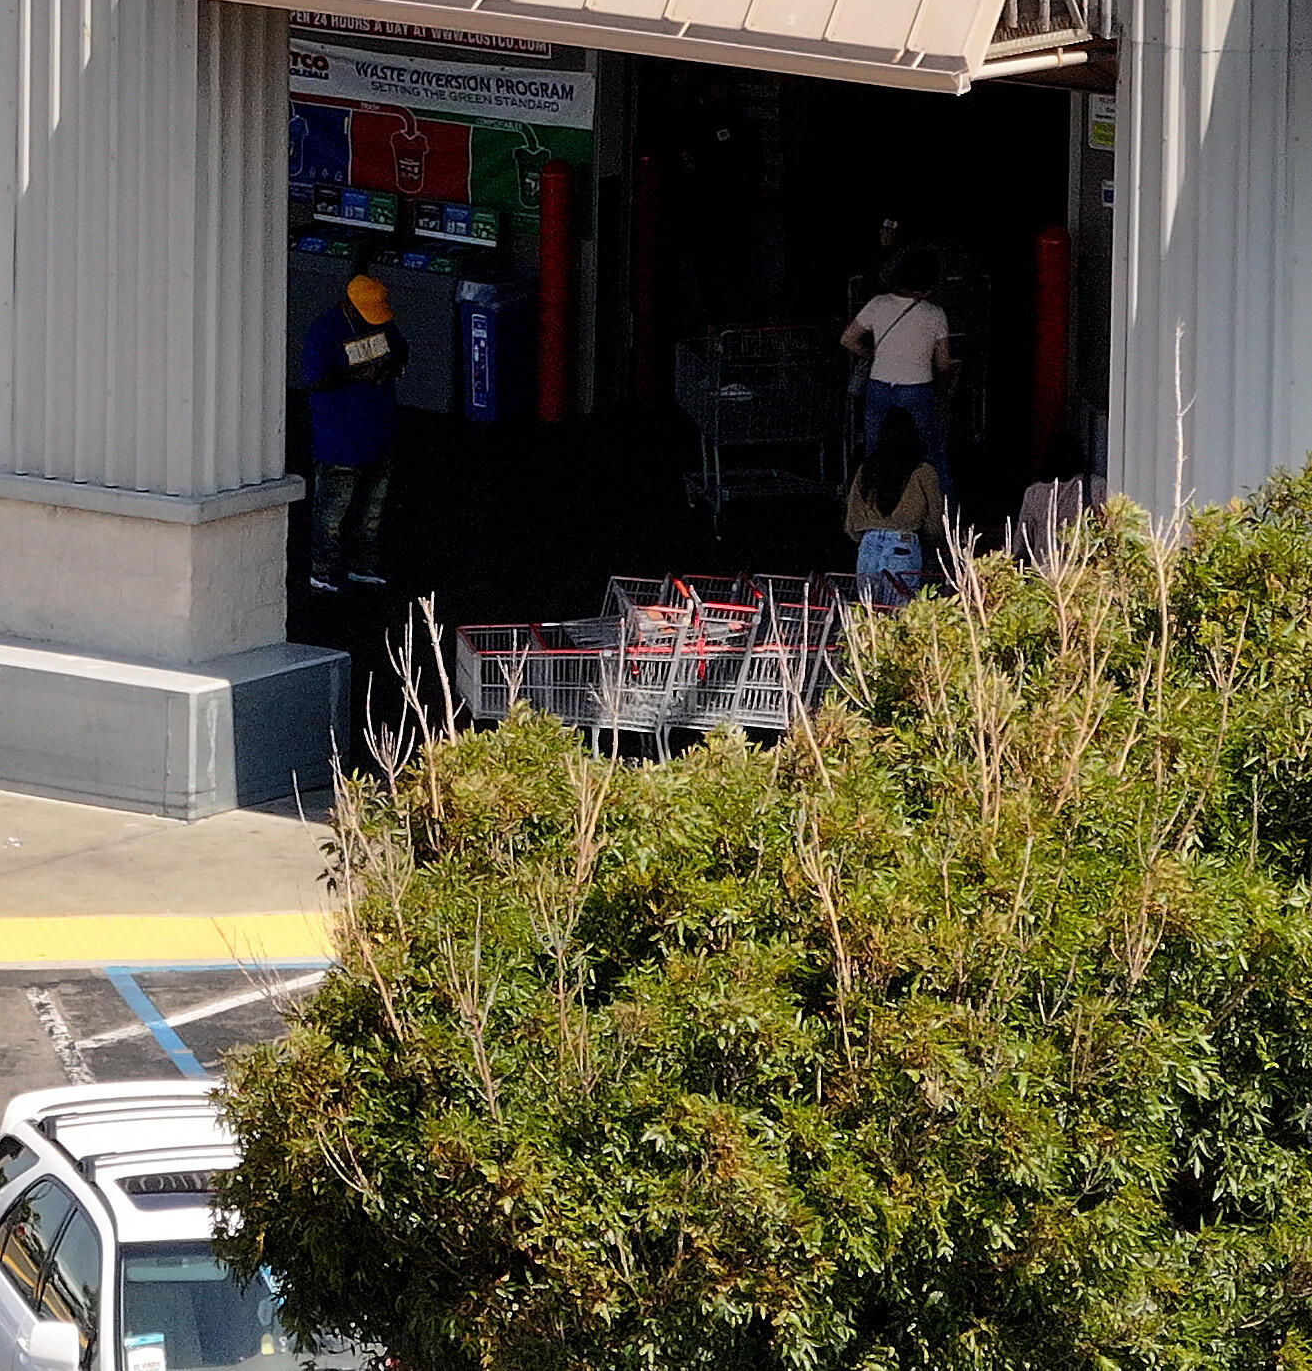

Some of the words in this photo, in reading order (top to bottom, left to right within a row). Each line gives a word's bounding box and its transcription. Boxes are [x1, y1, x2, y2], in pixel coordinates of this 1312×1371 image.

[289, 10, 311, 24] PEN
[313, 13, 328, 27] 24
[330, 15, 370, 31] HOURS
[373, 20, 384, 33] A
[385, 21, 409, 36] DAY
[413, 25, 427, 38] AT
[289, 51, 330, 71] TCO
[289, 67, 330, 81] OLESALE
[355, 60, 408, 83] WASTE
[409, 69, 491, 94] DIVERSION
[495, 76, 575, 101] PROGRAM
[371, 83, 421, 99] SETTING
[424, 88, 447, 103] THE
[449, 91, 493, 106] GREEN
[494, 95, 561, 113] STANDARD
